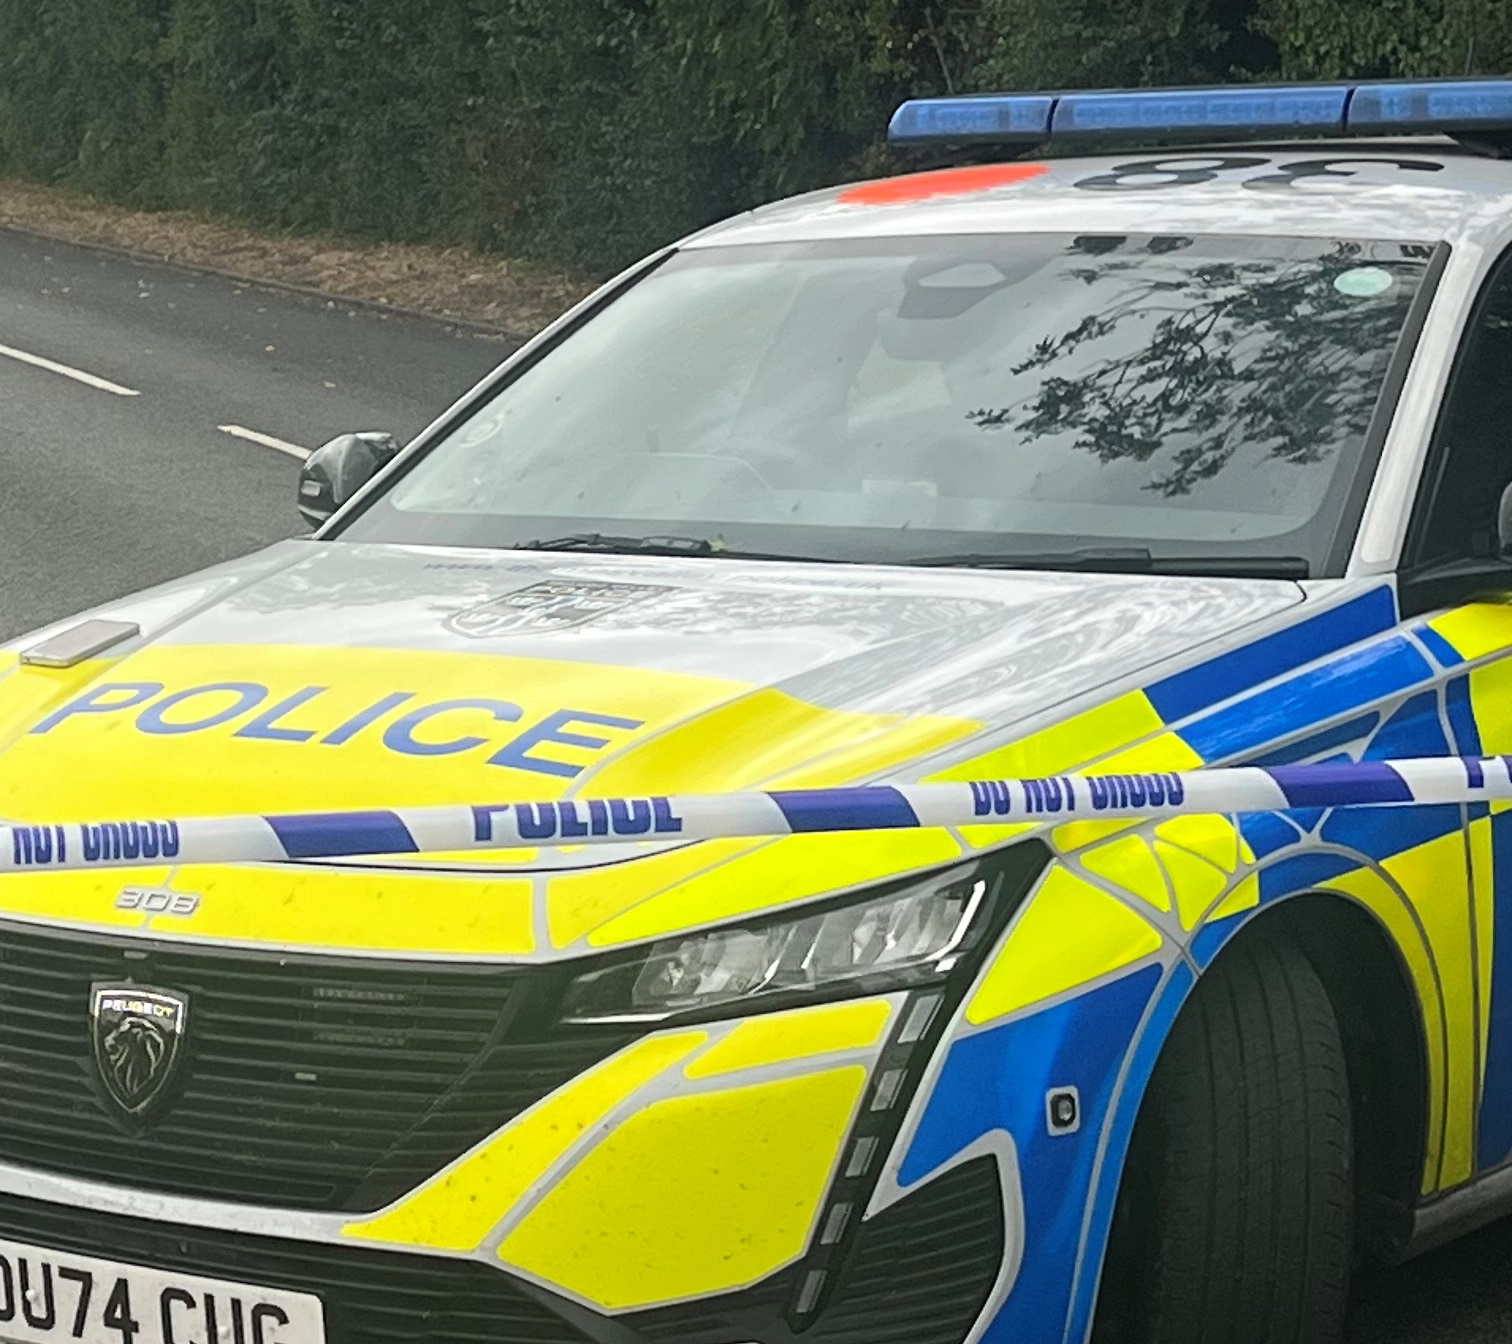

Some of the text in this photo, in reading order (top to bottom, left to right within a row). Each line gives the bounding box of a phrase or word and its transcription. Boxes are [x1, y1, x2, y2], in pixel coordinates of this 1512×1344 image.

[29, 681, 645, 778] POLICE
[114, 889, 201, 916] 308
[102, 999, 176, 1017] PEUGEOT
